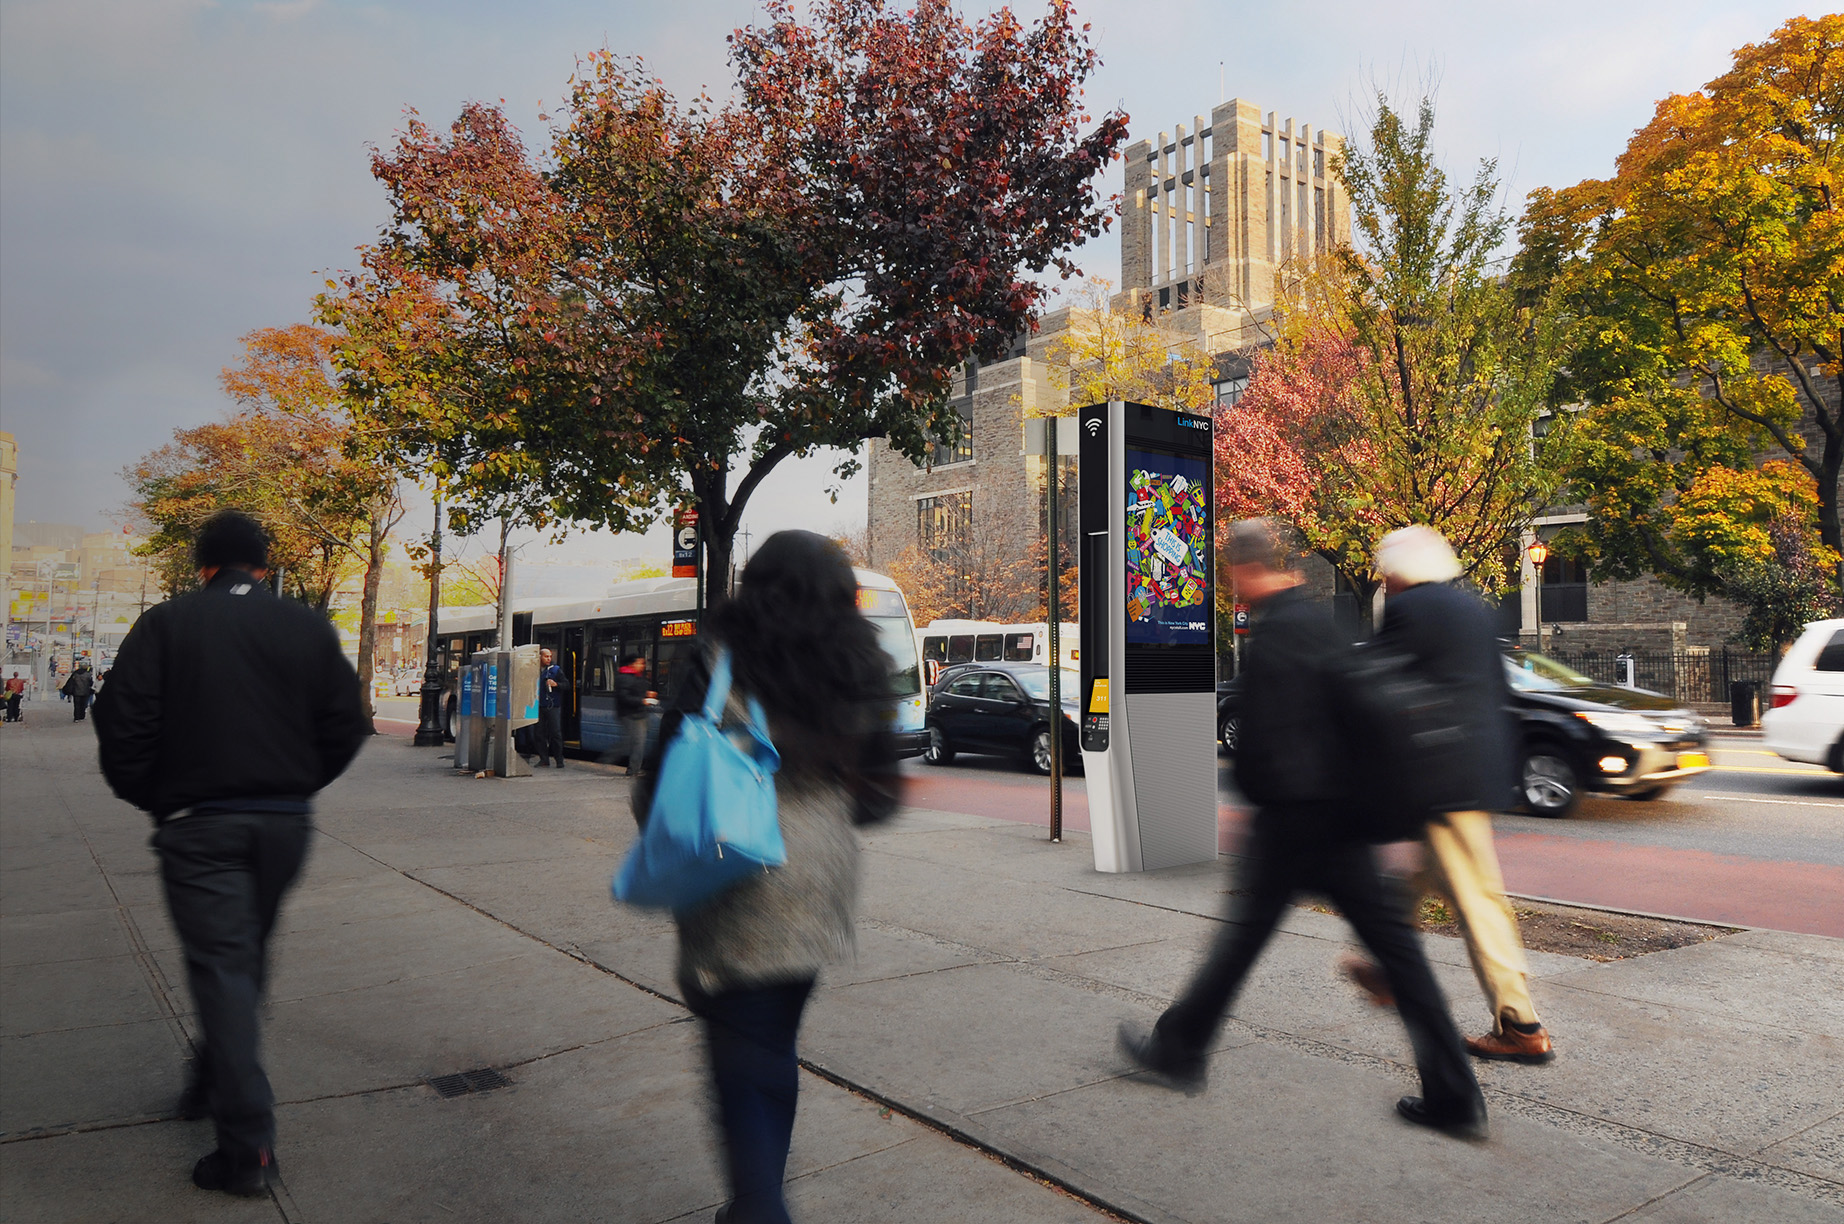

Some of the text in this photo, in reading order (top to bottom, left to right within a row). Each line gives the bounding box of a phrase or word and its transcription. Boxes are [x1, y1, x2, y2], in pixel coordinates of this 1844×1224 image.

[1177, 416, 1209, 430] LinkNYC
[1156, 537, 1182, 563] SHOPPING
[1165, 531, 1177, 547] THIS
[1176, 542, 1182, 552] IS
[1189, 622, 1206, 630] NYC
